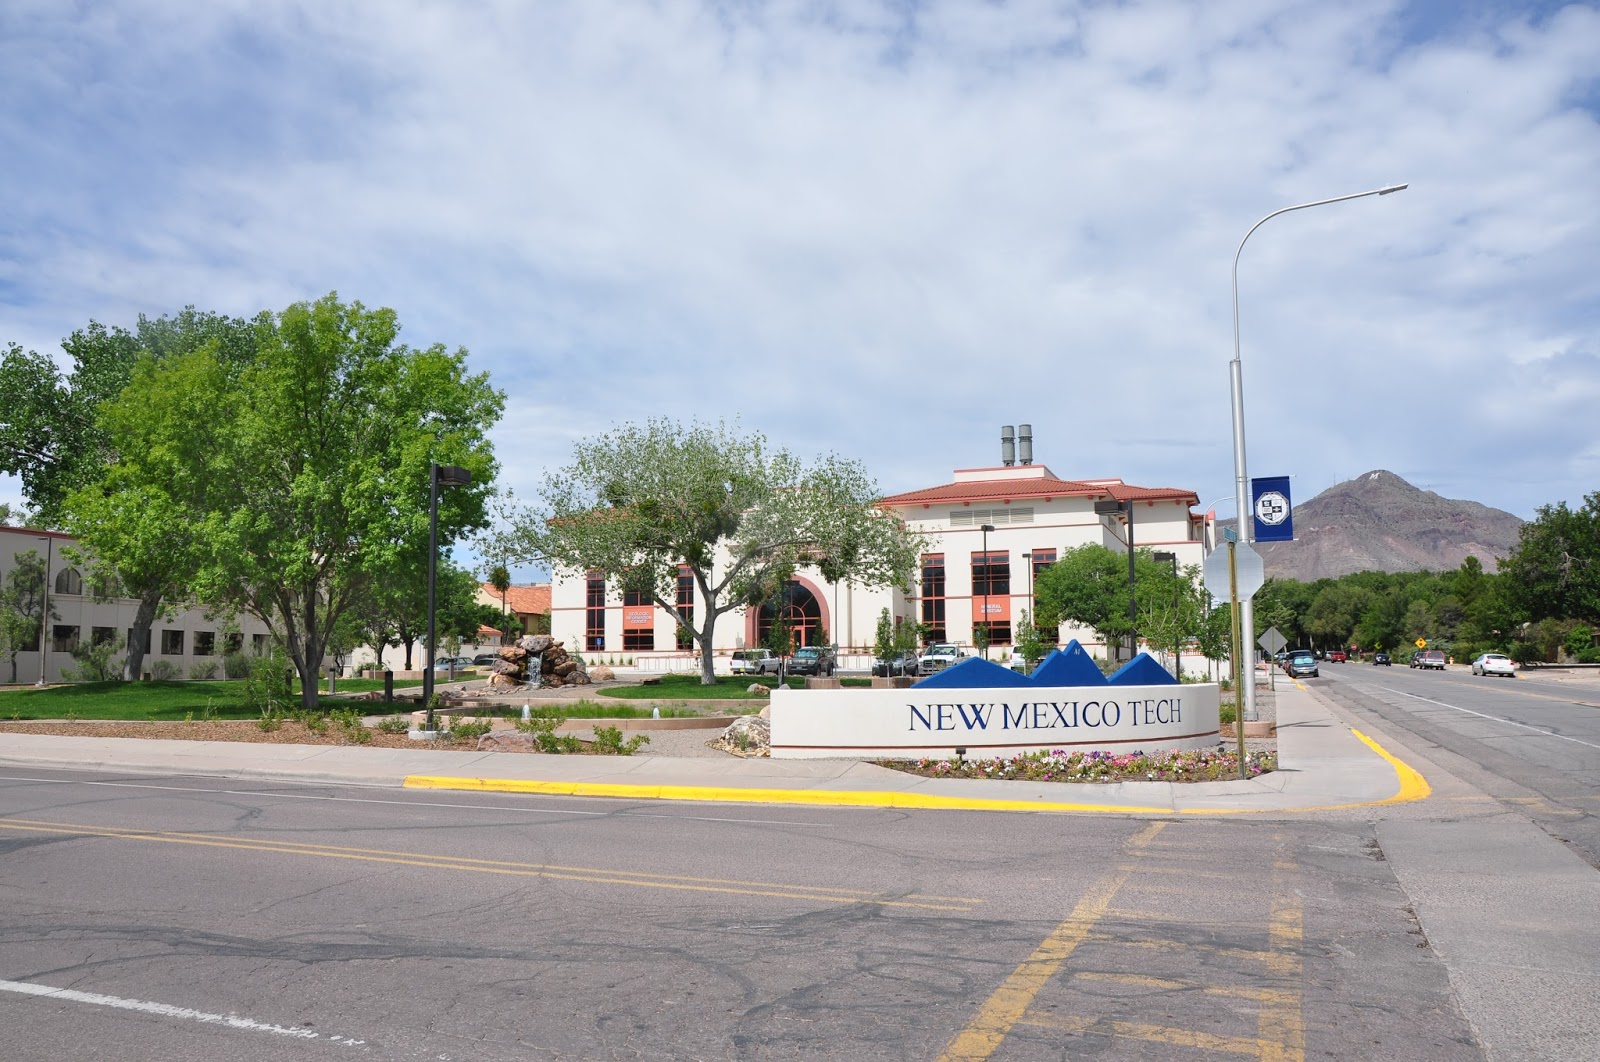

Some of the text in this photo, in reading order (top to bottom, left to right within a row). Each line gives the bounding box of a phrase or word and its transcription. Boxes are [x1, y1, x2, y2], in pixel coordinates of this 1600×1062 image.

[906, 698, 1182, 731] NEW MEXICO TECH
